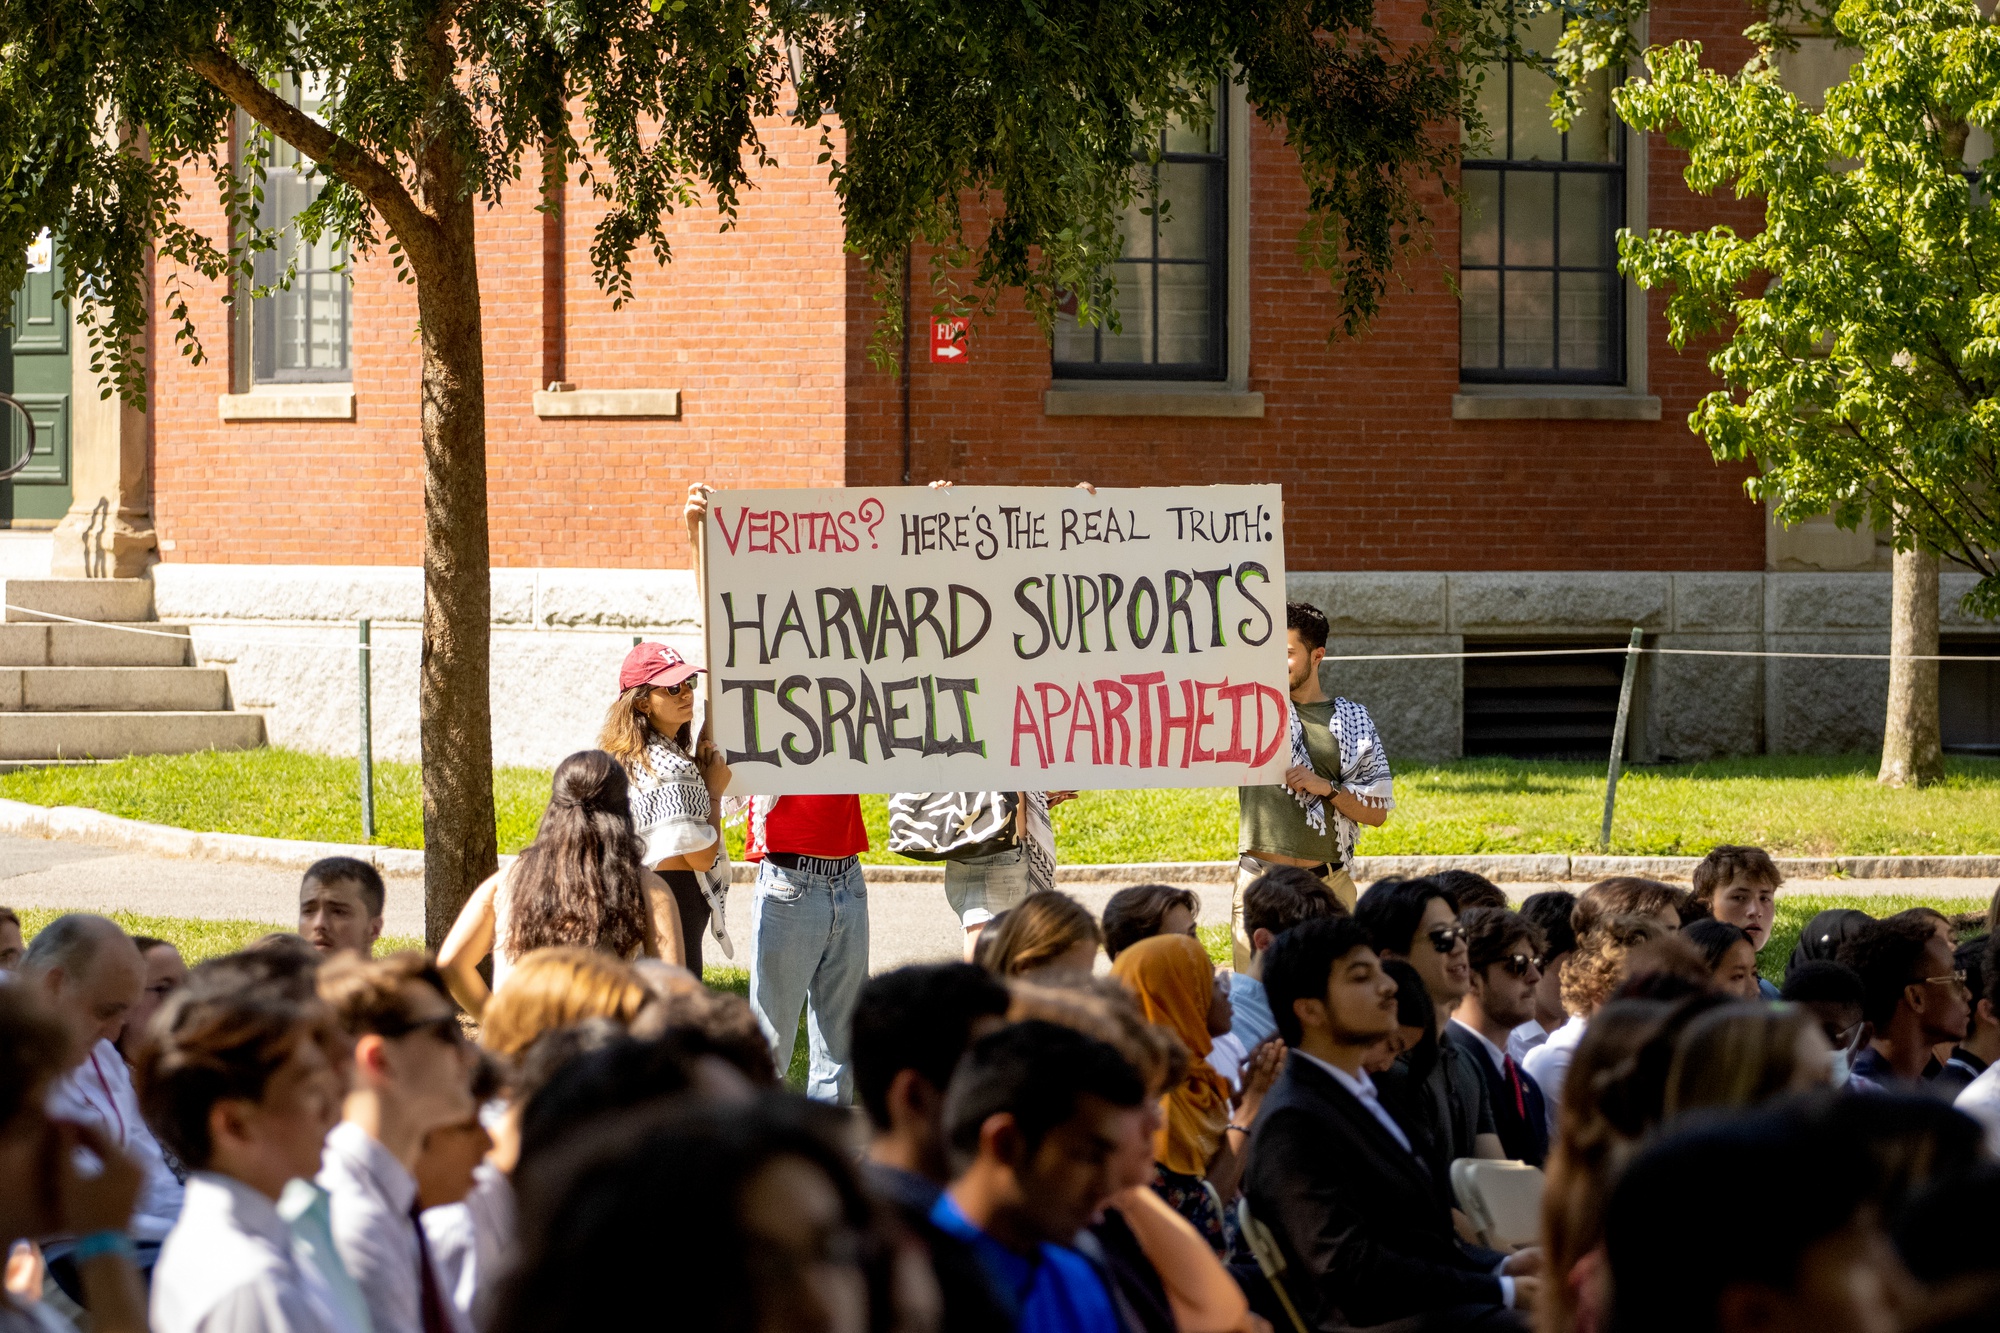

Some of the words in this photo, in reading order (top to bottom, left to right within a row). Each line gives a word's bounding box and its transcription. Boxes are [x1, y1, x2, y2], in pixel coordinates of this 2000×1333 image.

[714, 497, 885, 556] VERITAS?
[900, 505, 999, 560] HERE'S
[999, 505, 1049, 550] THE
[1060, 507, 1150, 550] REAL
[1166, 504, 1273, 543] TRUTH:
[720, 584, 992, 667] HARVARD
[1014, 561, 1273, 660] SUPPORTS
[721, 668, 988, 768] ISRAELI
[1010, 670, 1288, 769] APARTHEID
[796, 856, 840, 876] CALVIN
